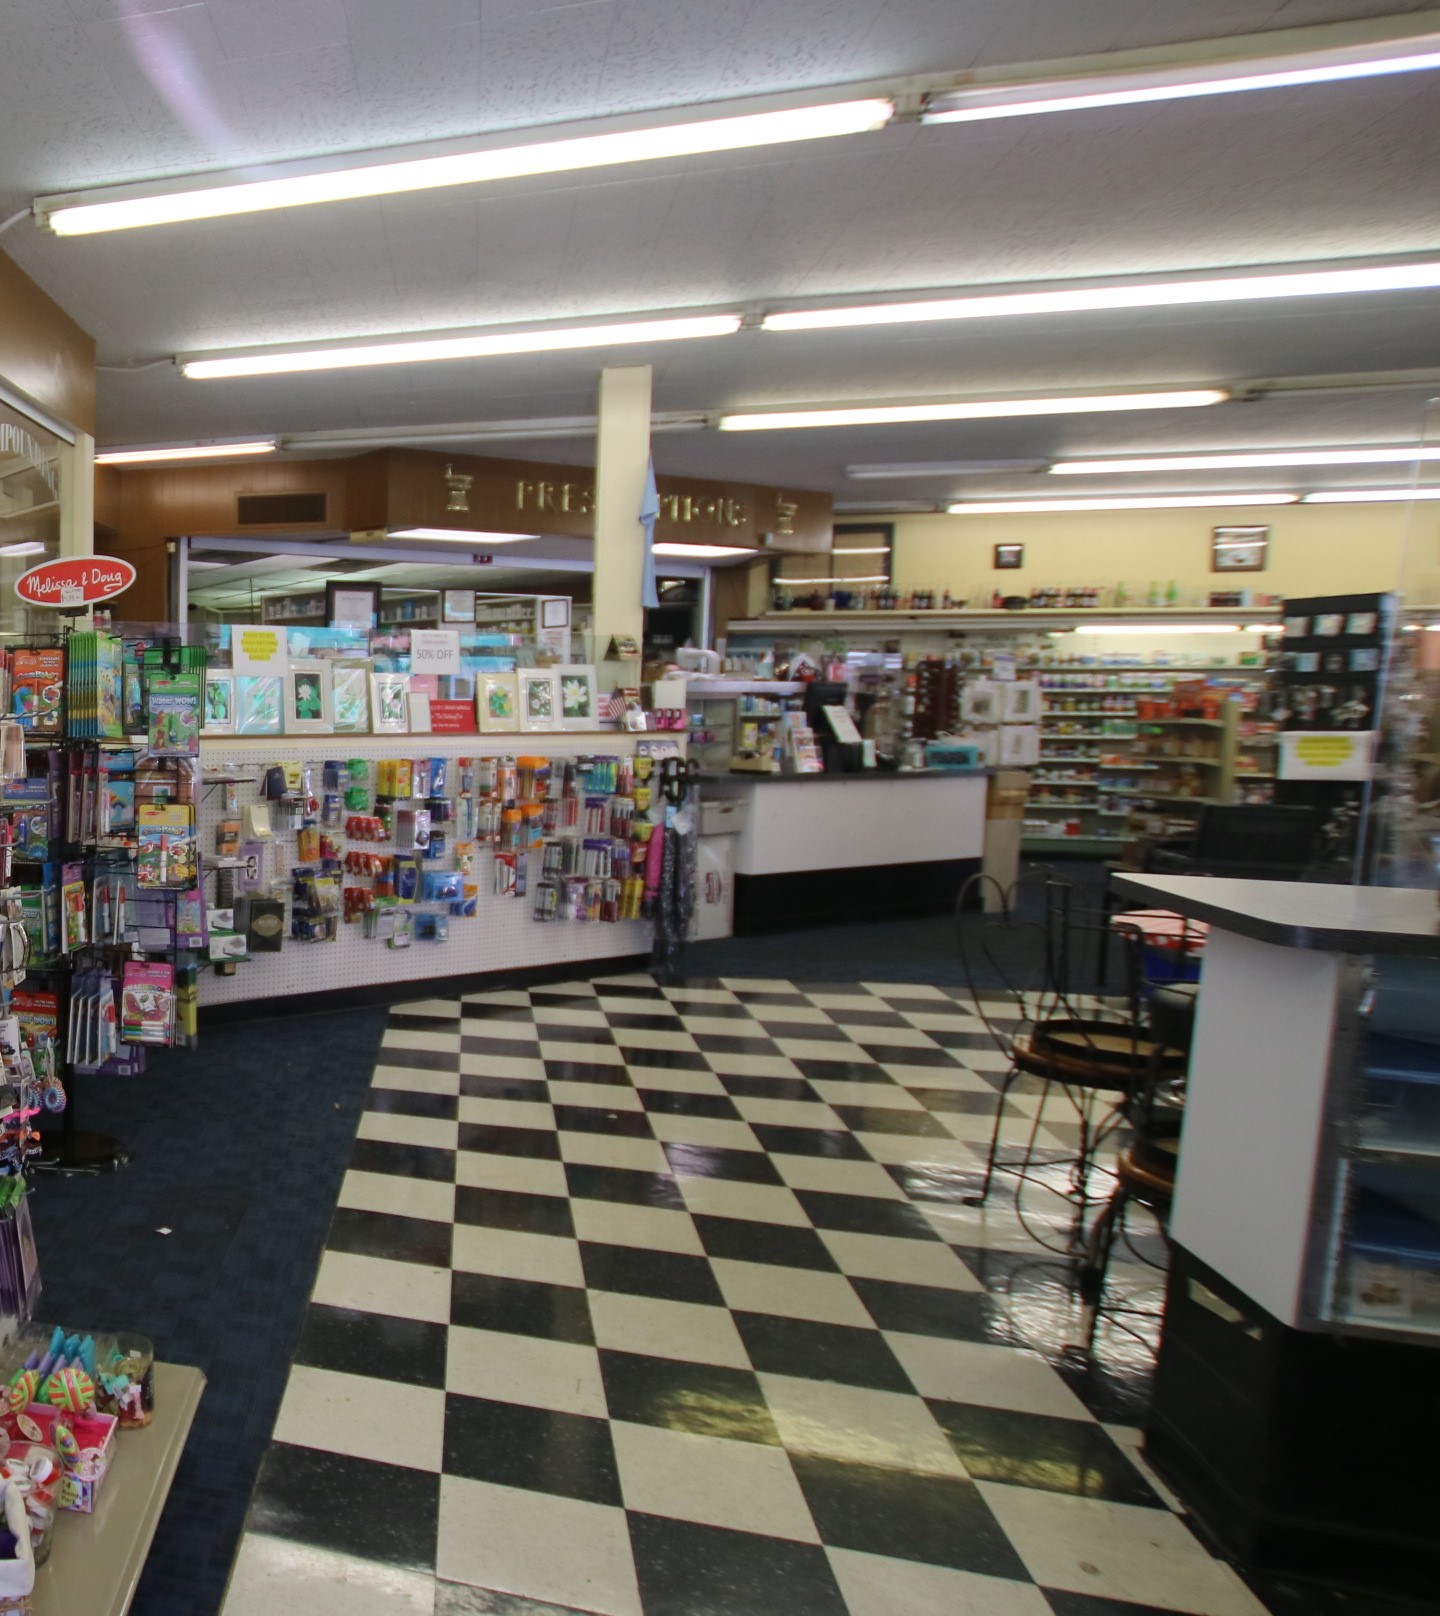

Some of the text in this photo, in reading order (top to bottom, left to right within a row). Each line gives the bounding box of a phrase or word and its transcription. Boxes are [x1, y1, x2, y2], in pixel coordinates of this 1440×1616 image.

[27, 575, 77, 598] Melissa
[91, 568, 126, 592] Doug
[416, 649, 454, 660] 50% OFF
[174, 696, 197, 706] WOW!
